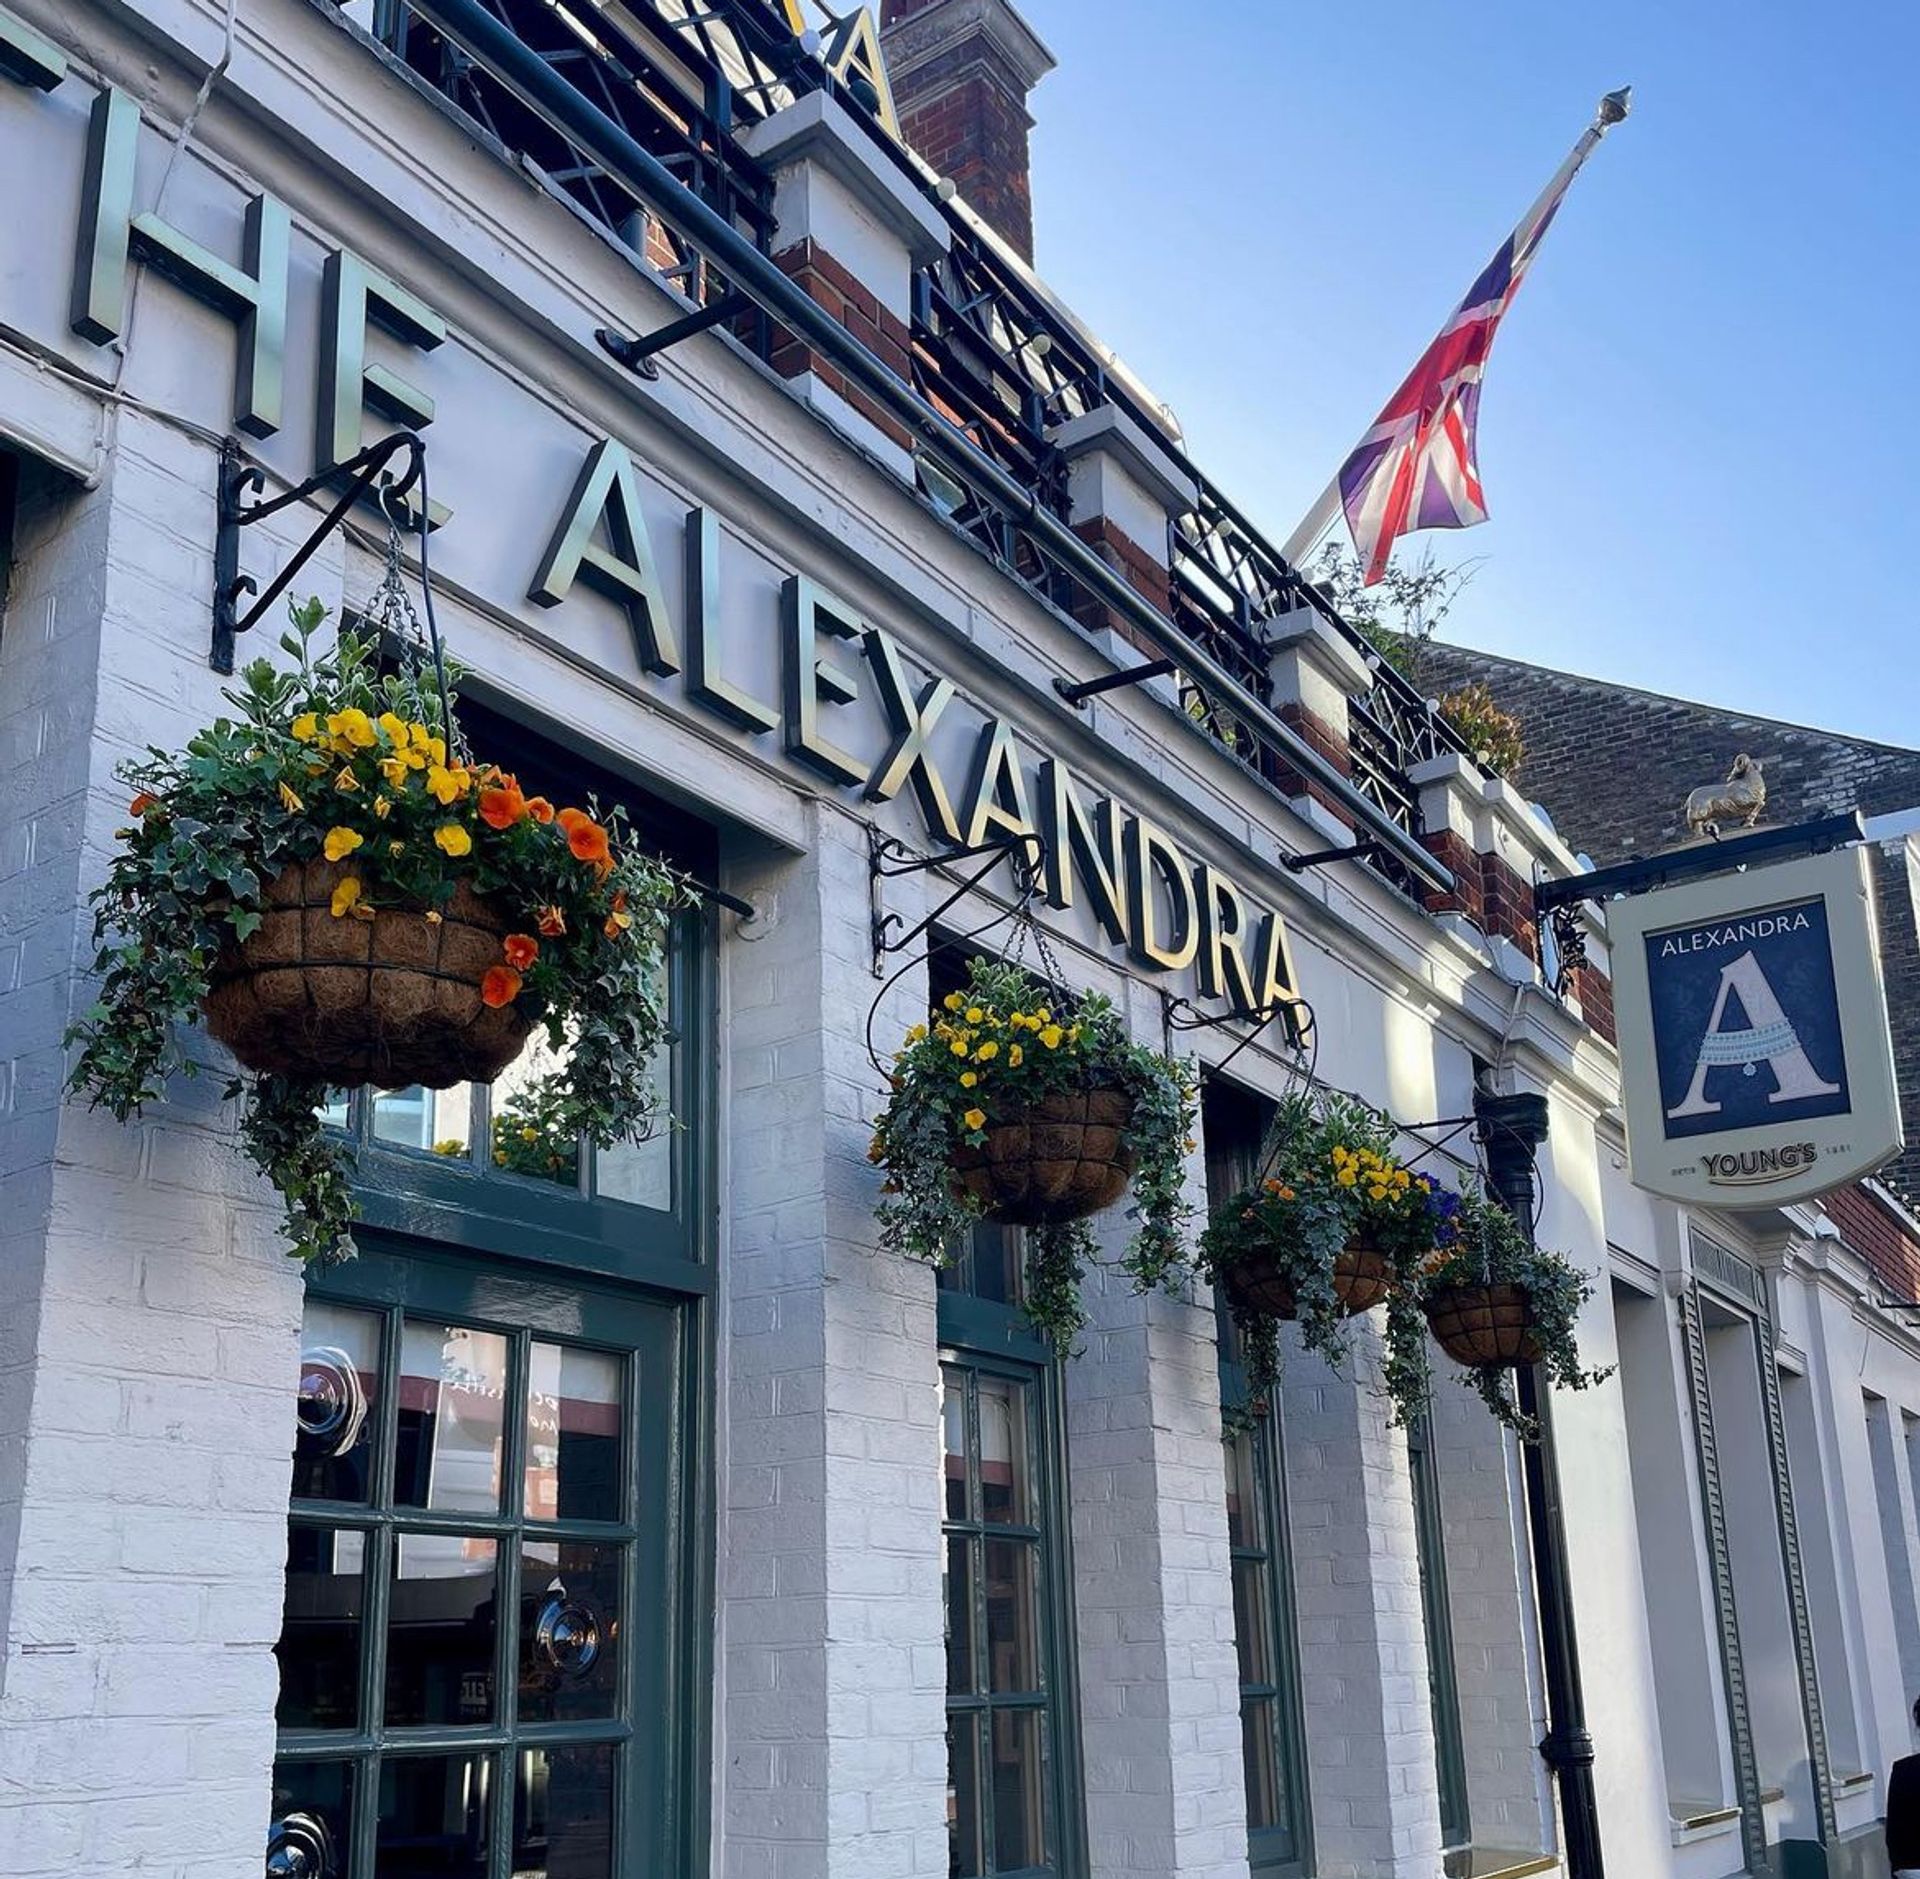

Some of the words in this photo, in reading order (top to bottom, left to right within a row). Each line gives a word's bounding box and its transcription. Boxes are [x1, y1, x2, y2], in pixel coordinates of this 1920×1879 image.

[0, 10, 455, 533] HE
[527, 438, 1312, 1049] ALEXANDRA
[1661, 912, 1809, 957] ALEXANDRA
[1667, 950, 1841, 1119] A
[1701, 1142, 1818, 1177] YOUNG'S
